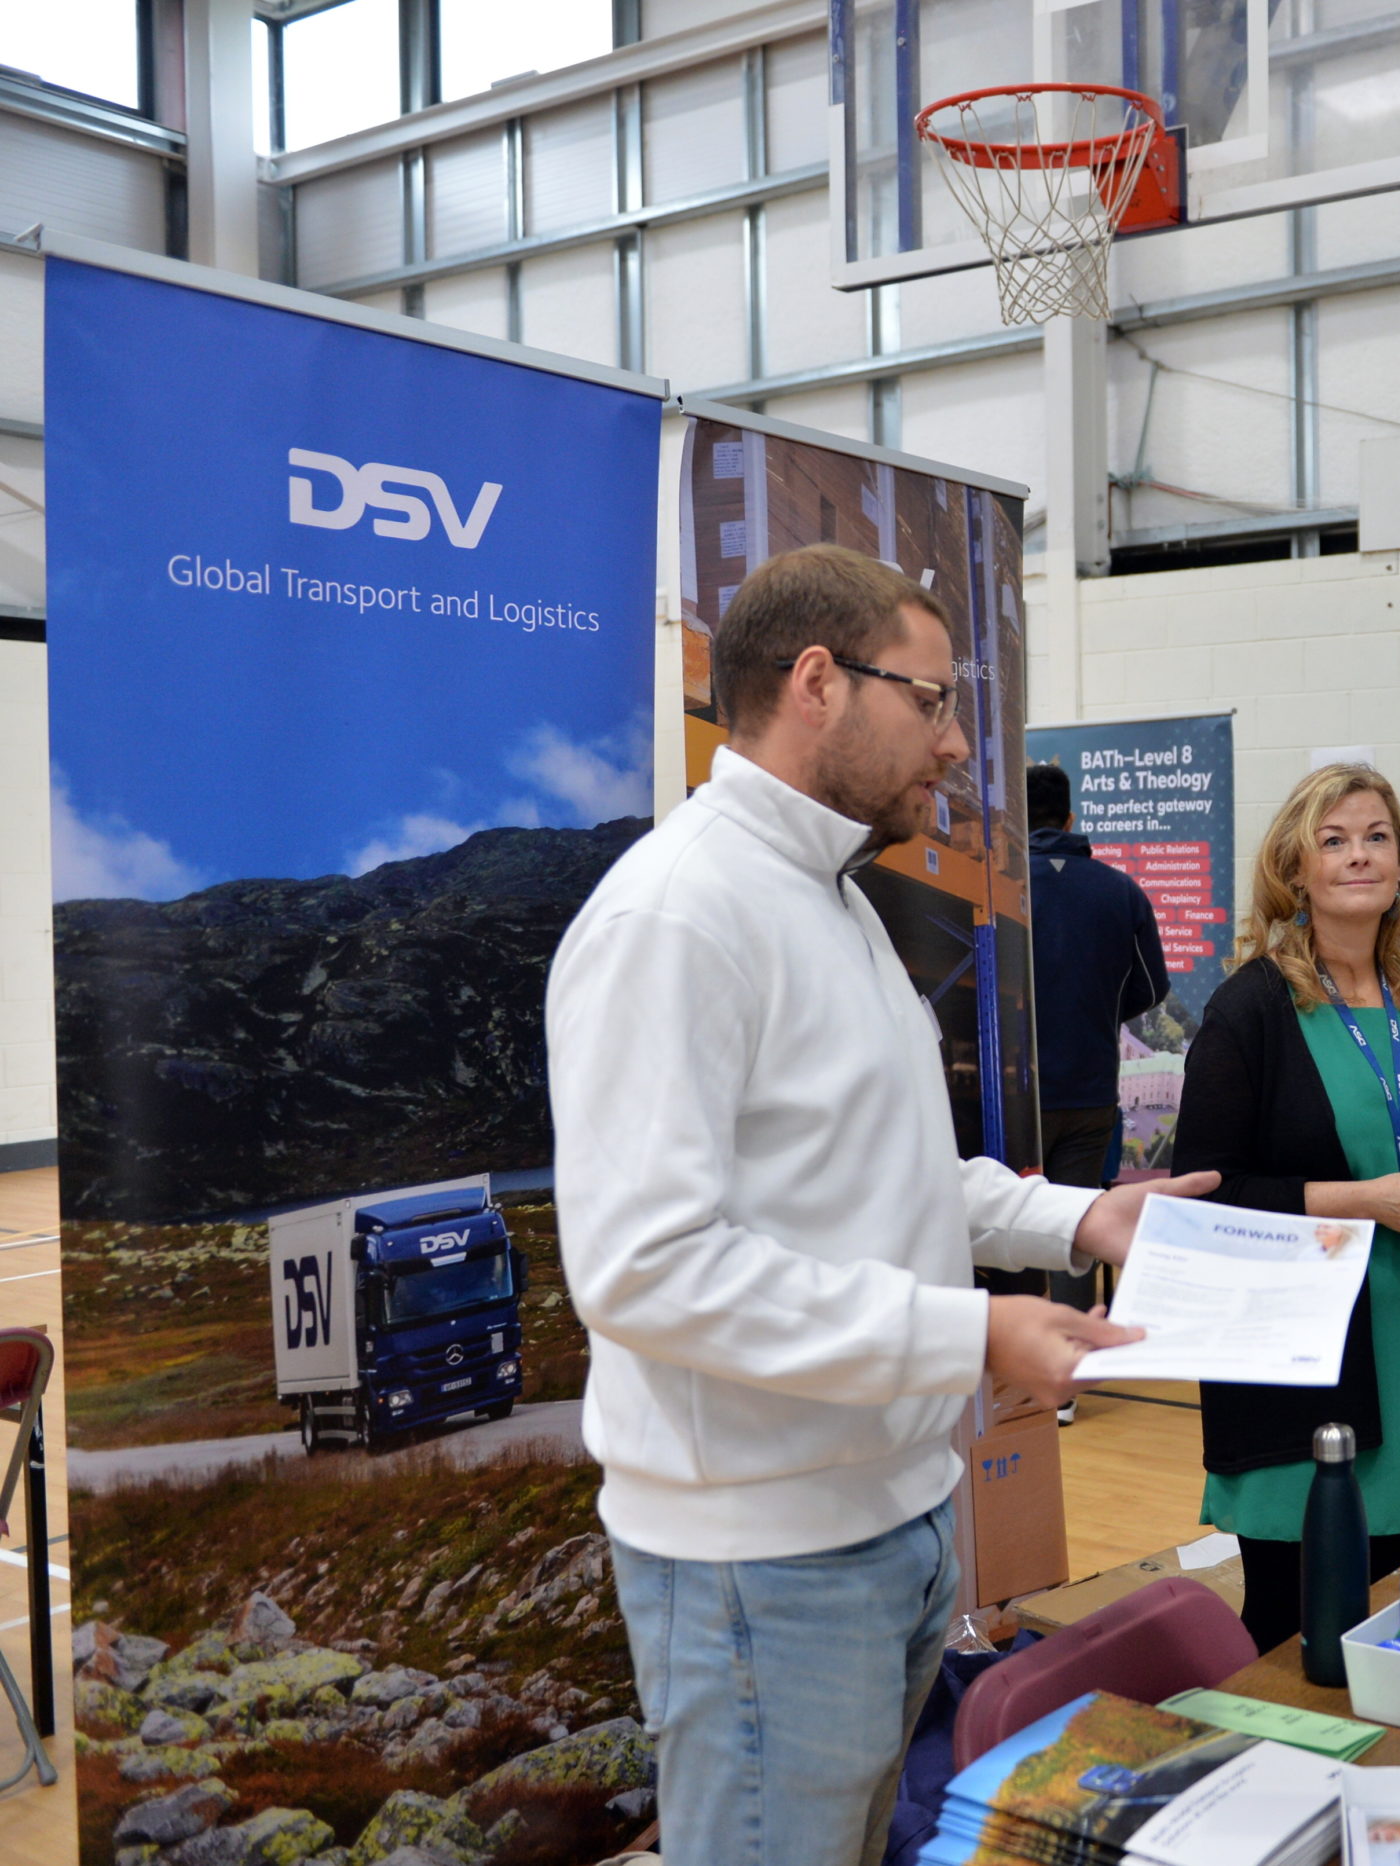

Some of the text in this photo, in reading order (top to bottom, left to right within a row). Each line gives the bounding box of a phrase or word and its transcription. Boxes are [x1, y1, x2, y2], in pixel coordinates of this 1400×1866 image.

[288, 447, 503, 549] DSV
[167, 554, 601, 632] Global Transport and Logistics
[951, 657, 996, 681] gistics
[1182, 745, 1193, 764] 8
[1081, 769, 1213, 792] Arts & Theology
[1081, 799, 1213, 817] The perfect gateway
[1081, 819, 1094, 832] to
[1096, 819, 1143, 832] careers
[1140, 845, 1200, 855] Public Relations
[1146, 861, 1200, 871] Administration
[1139, 878, 1202, 888] Communications
[1161, 894, 1201, 905] Chaplaincy
[1185, 910, 1214, 920] Finance
[1165, 927, 1192, 936] Service
[1172, 943, 1204, 953] Services
[1349, 1024, 1367, 1047] DSV
[1390, 1019, 1400, 1042] DSV
[1380, 1076, 1392, 1101] DSV
[419, 1228, 471, 1255] DSV
[1213, 1223, 1300, 1244] FORWARD
[283, 1251, 333, 1350] DSV
